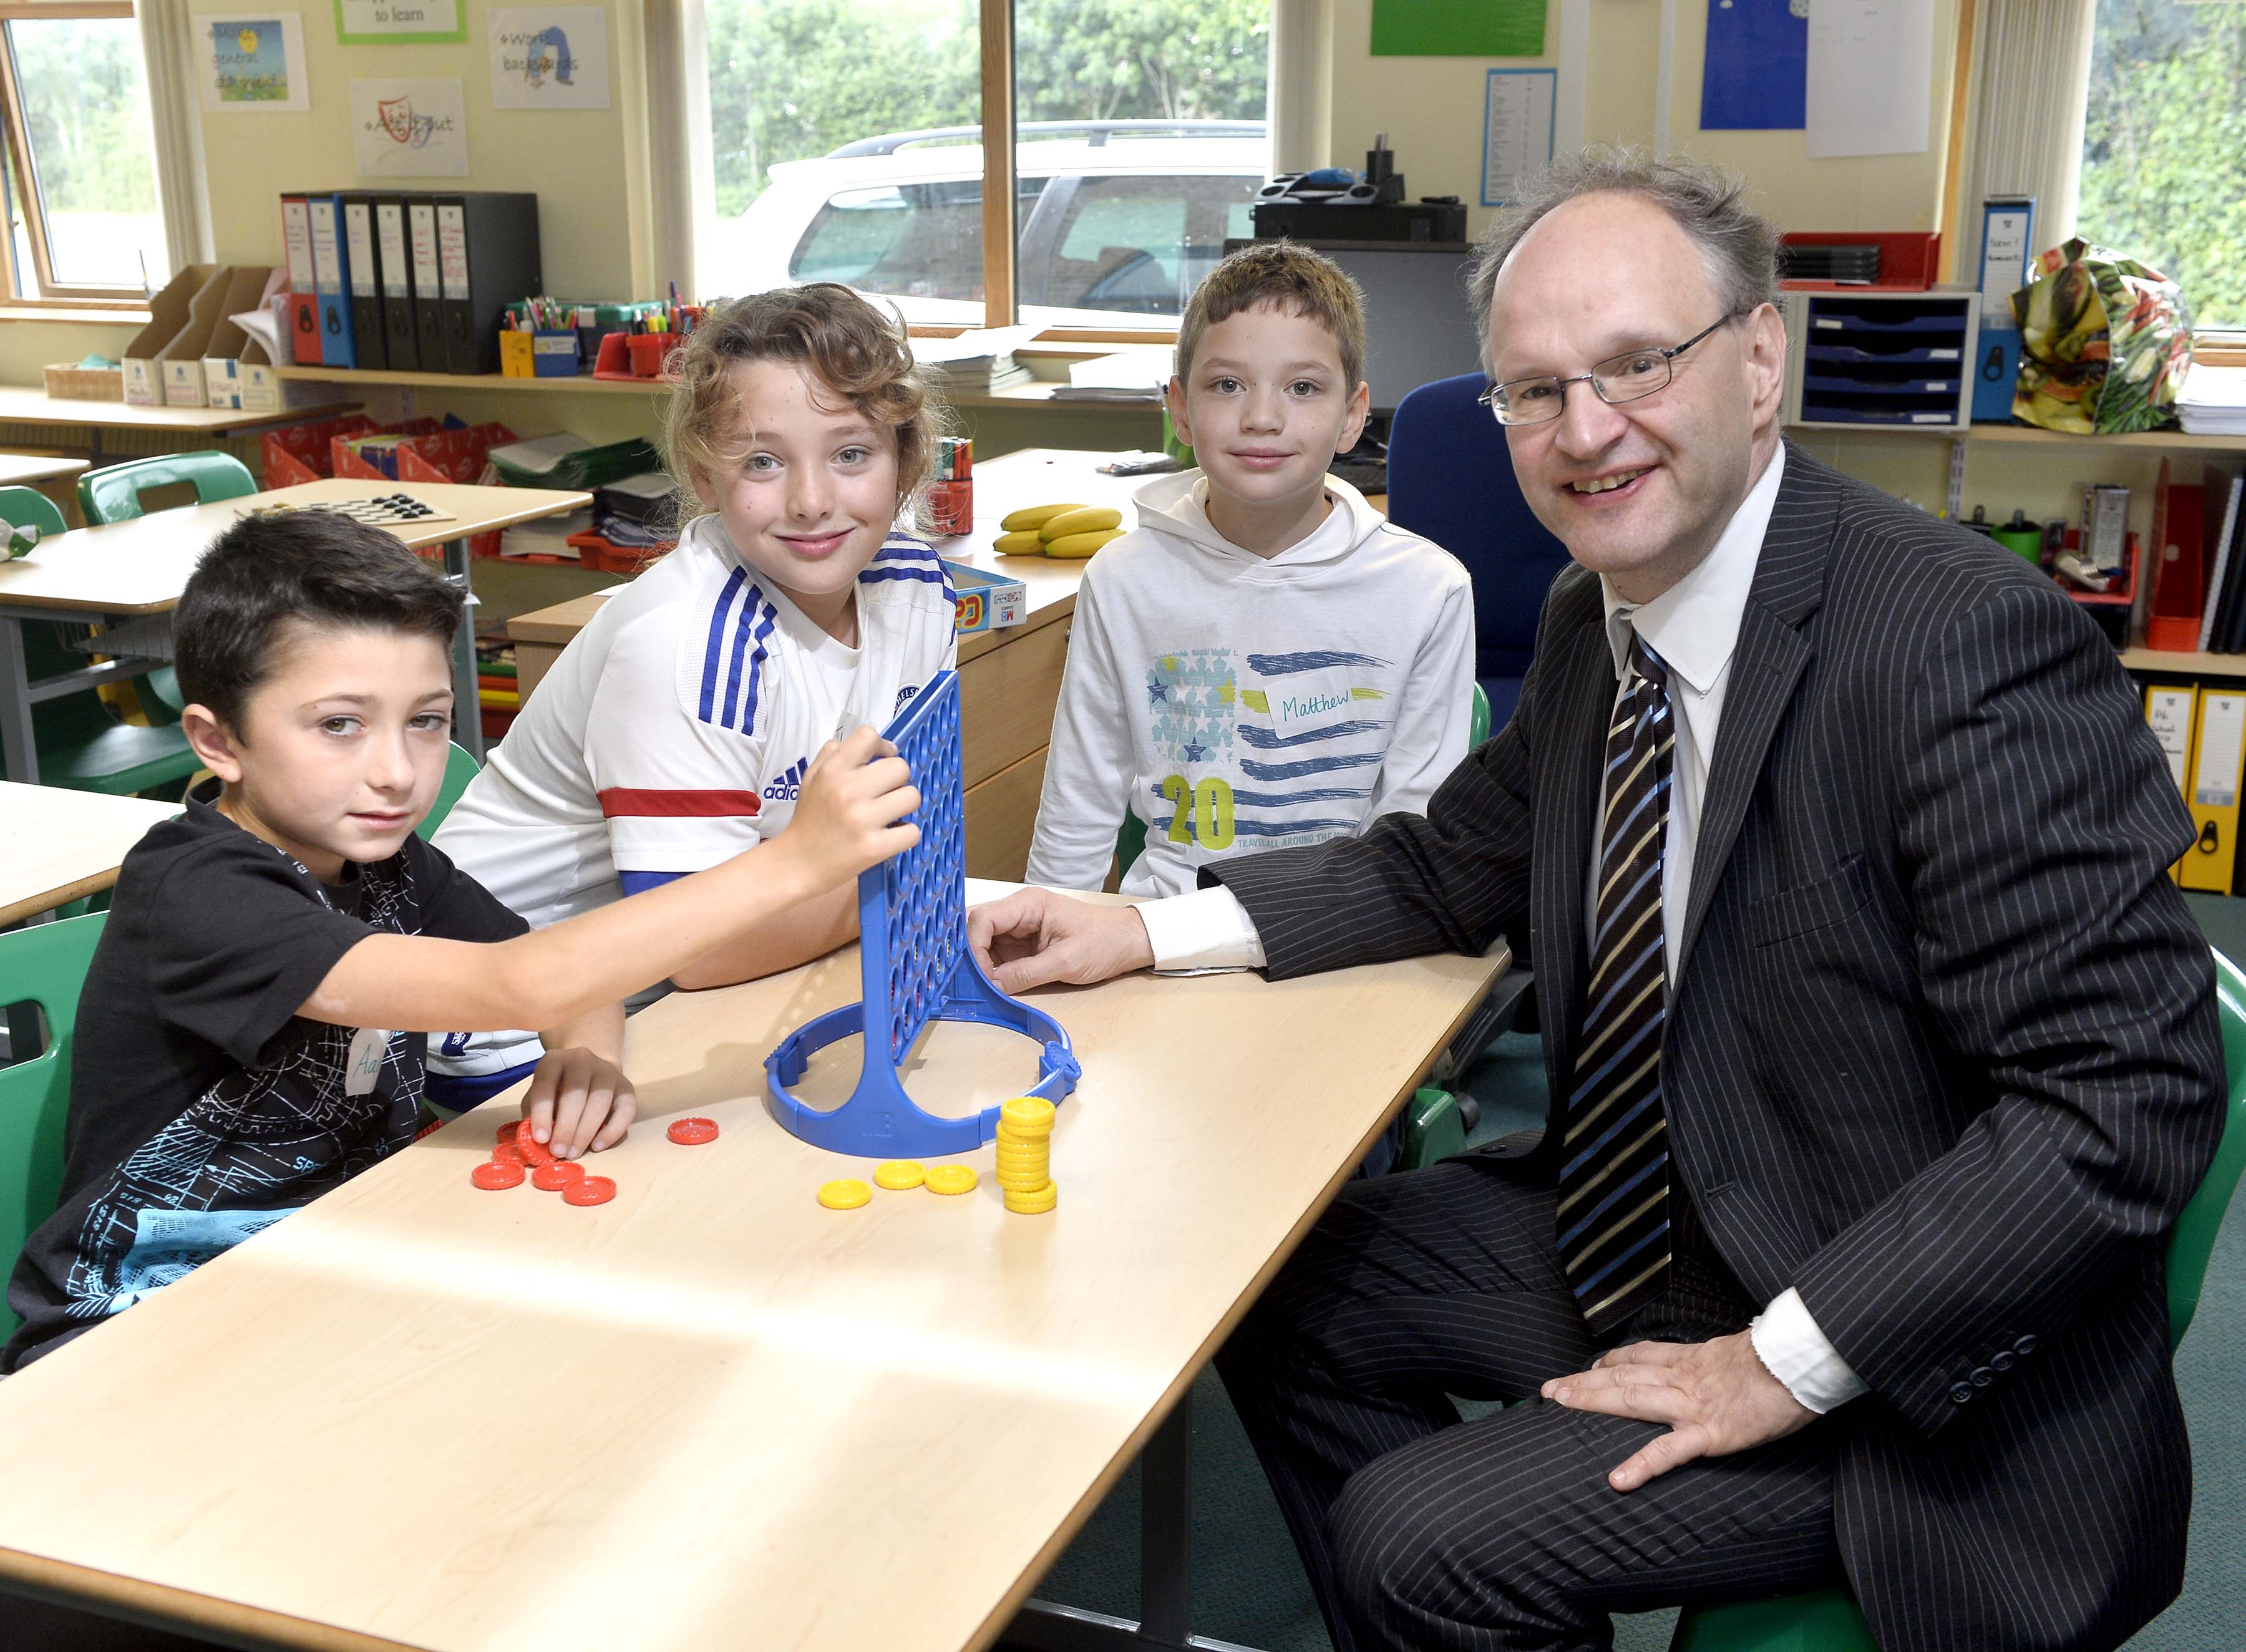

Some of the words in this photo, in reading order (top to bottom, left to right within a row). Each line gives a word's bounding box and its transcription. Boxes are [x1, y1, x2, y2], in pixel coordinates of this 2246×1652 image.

[375, 10, 389, 21] to
[391, 6, 425, 21] learn
[1001, 610, 1014, 622] MB
[1282, 689, 1349, 722] Matthew
[1163, 774, 1235, 850] 20
[1238, 839, 1266, 848] TRAVEL
[1266, 839, 1279, 848] ALL
[1281, 835, 1314, 847] AROUND
[1316, 832, 1333, 843] THE
